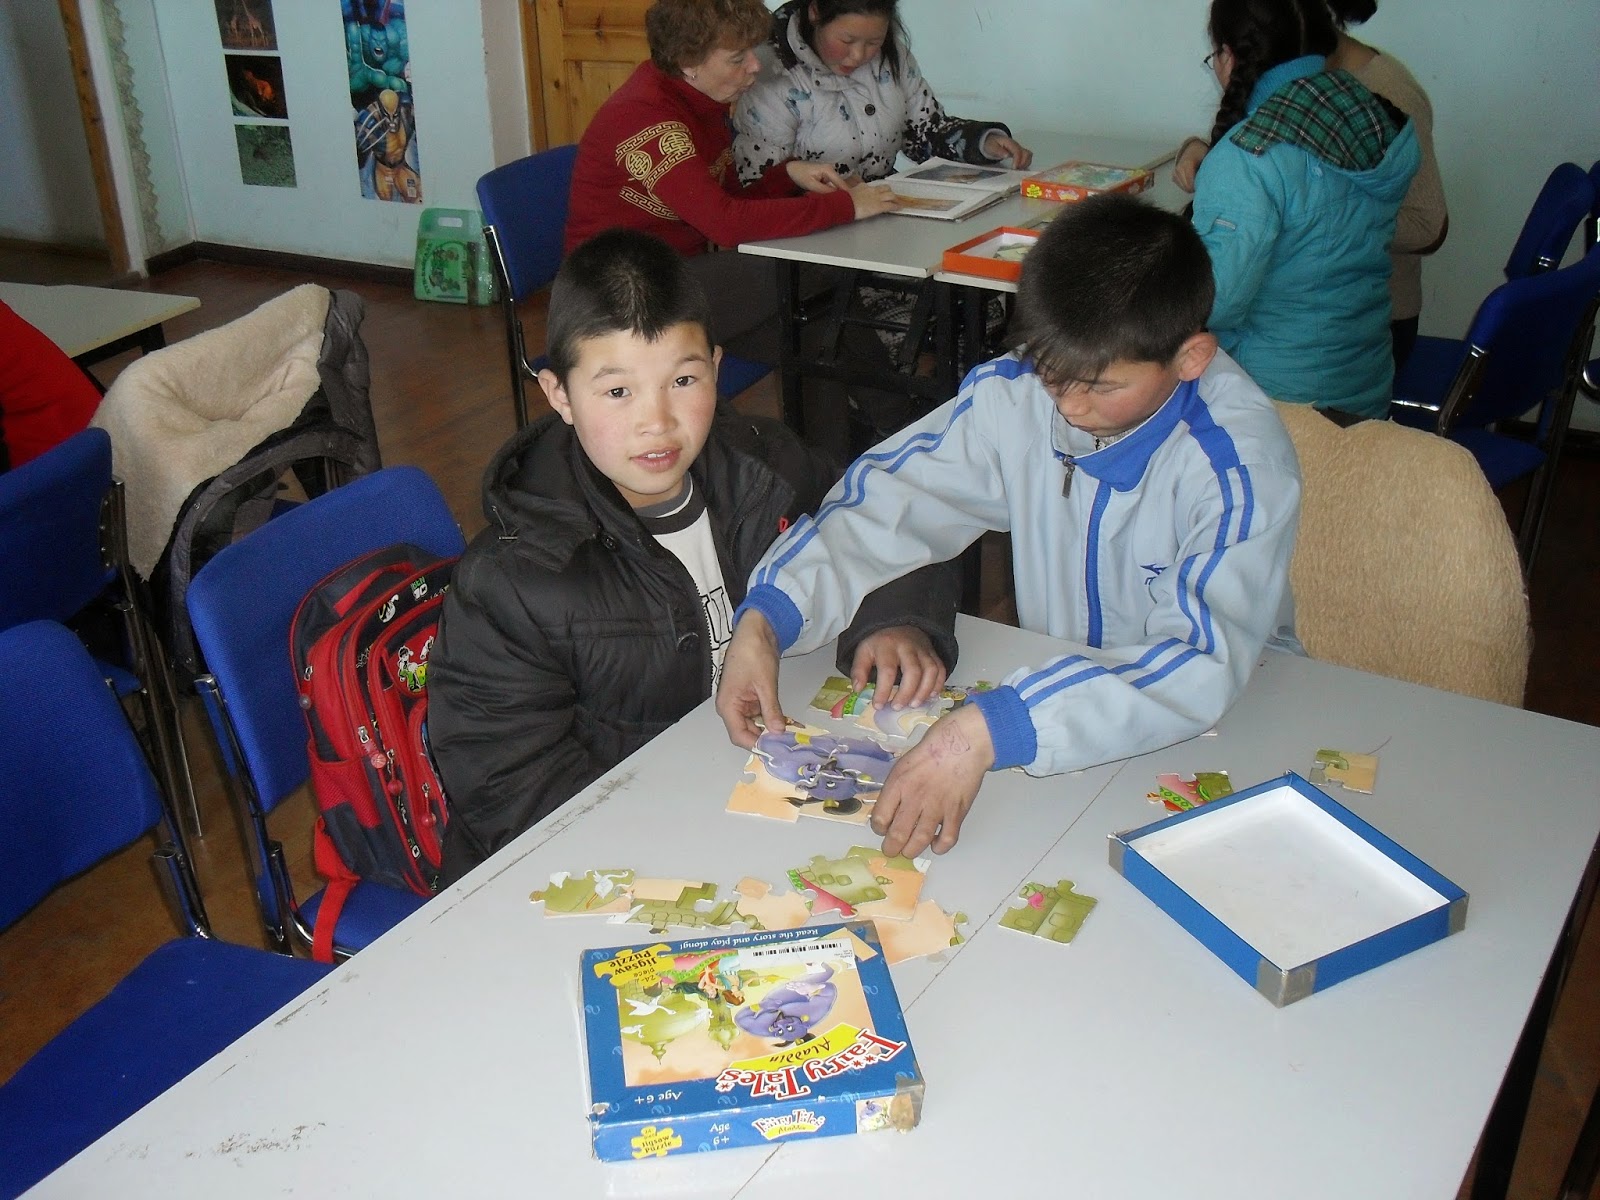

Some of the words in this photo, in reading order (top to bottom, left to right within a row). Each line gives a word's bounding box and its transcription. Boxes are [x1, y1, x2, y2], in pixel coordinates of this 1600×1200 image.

[752, 933, 777, 942] story
[779, 931, 793, 939] the
[795, 929, 819, 938] Read
[680, 941, 709, 950] along!
[711, 938, 731, 947] play
[732, 936, 751, 946] and
[609, 950, 652, 967] Puzzle
[614, 957, 657, 975] Jigsaw
[633, 967, 656, 978] piece
[770, 1037, 831, 1063] Aladdin
[804, 1029, 905, 1081] Fairy
[716, 1067, 810, 1100] Tales
[634, 1095, 654, 1104] 6+
[662, 1090, 683, 1101] Age
[709, 1122, 731, 1133] Age
[713, 1136, 730, 1146] 6+
